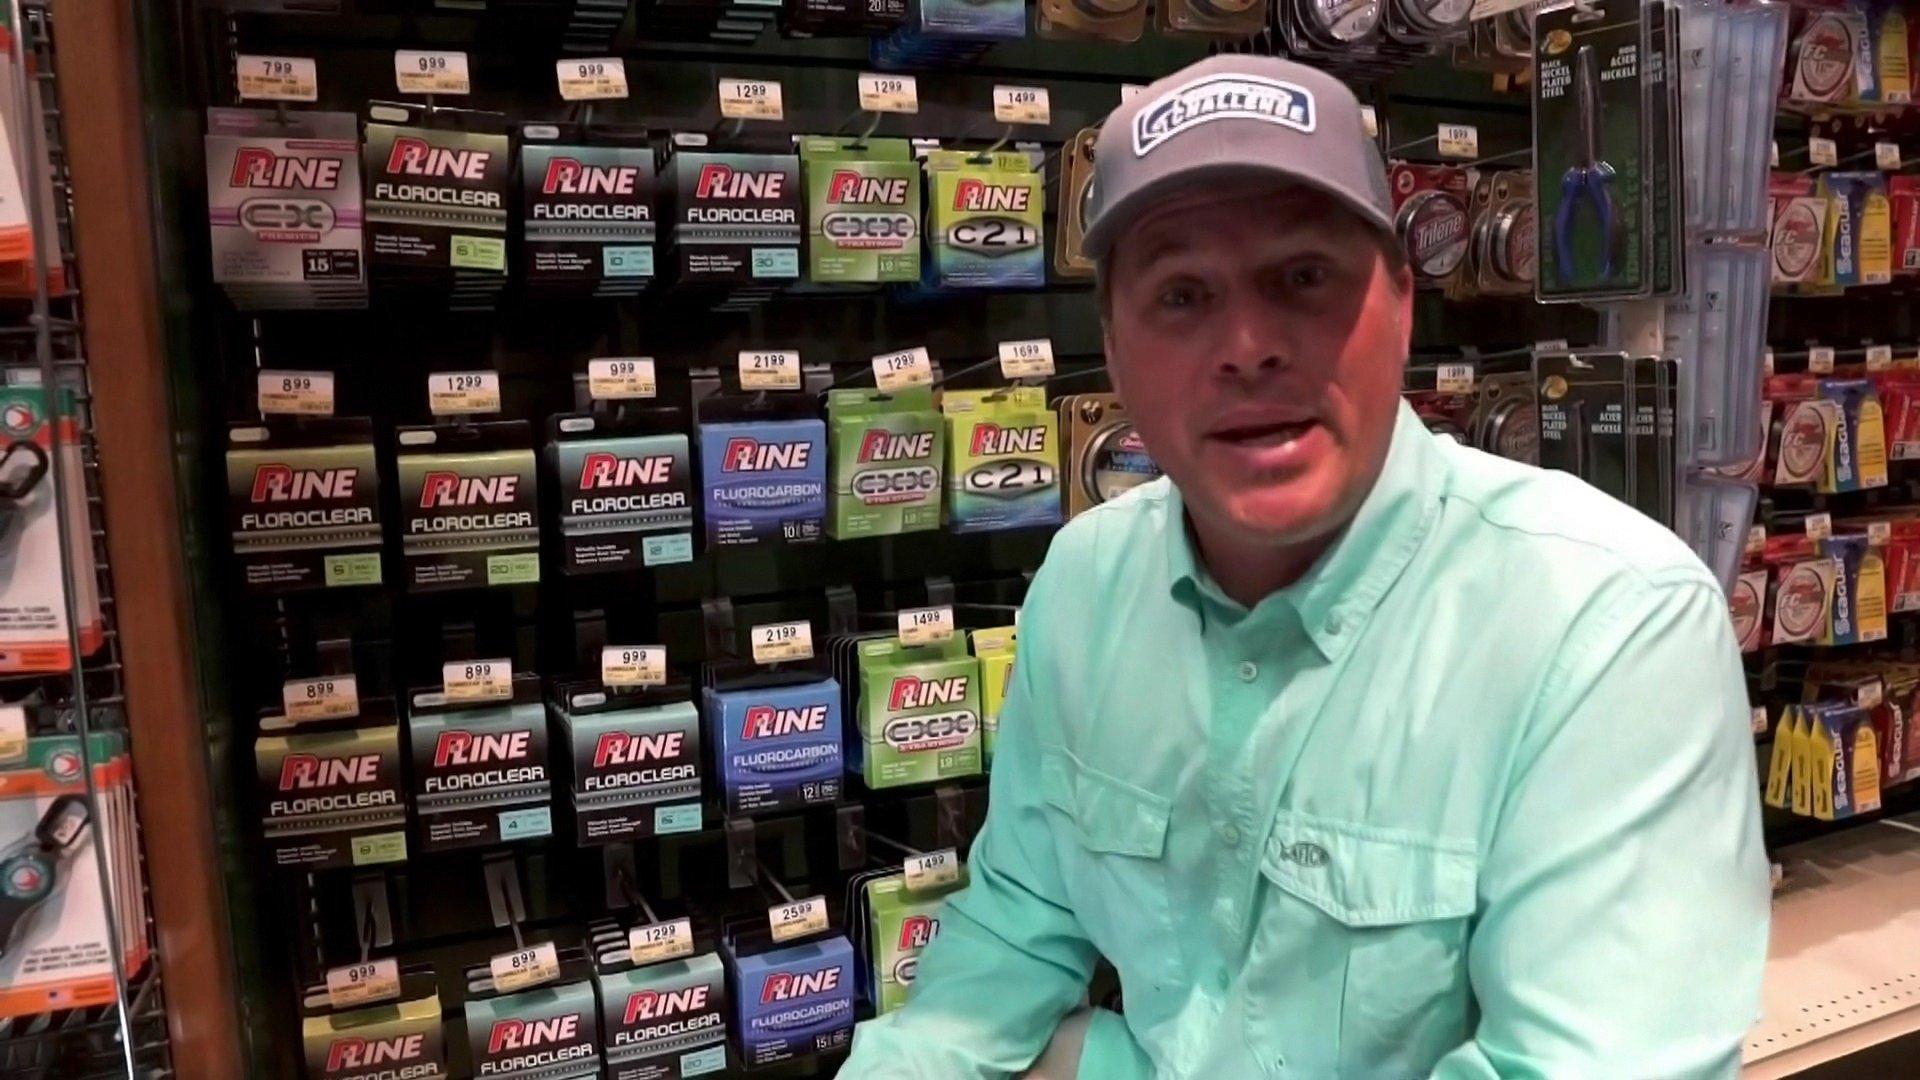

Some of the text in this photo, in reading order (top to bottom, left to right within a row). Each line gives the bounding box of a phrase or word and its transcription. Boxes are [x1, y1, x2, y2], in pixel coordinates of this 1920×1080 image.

[263, 61, 292, 77] 799
[419, 57, 446, 71] 999
[1610, 55, 1637, 67] ACIER
[578, 65, 604, 78] 999
[1541, 66, 1570, 79] NICKEL
[874, 80, 902, 93] 1299
[1542, 76, 1572, 89] PLATED
[736, 84, 766, 99] 1299
[1008, 92, 1036, 104] 1499
[1542, 87, 1565, 98] STEEL
[376, 184, 500, 207] FLOROCLEAR
[533, 204, 649, 220] FLOROCLEAR
[688, 208, 795, 223] FLOROCLEAR
[954, 221, 1029, 246] C21
[1418, 214, 1464, 250] Trilene
[308, 258, 329, 272] 15
[755, 258, 774, 268] 30
[1013, 344, 1040, 358] 1699
[610, 363, 635, 376] 999
[754, 355, 785, 369] 2199
[888, 353, 916, 371] 1299
[283, 377, 311, 392] 899
[447, 375, 482, 391] 1299
[1600, 412, 1622, 422] ACIER
[1542, 421, 1567, 430] PLATED
[971, 464, 1047, 489] C21
[713, 482, 821, 500] FLUOROCARBON
[571, 491, 686, 514] FLOROCLEAR
[242, 508, 372, 530] FLOROCLEAR
[411, 512, 532, 533] FLOROCLEAR
[783, 526, 796, 539] 10
[913, 610, 940, 626] 1499
[766, 627, 796, 642] 2199
[623, 650, 647, 664] 999
[465, 665, 491, 679] 899
[307, 682, 334, 698] 899
[733, 744, 839, 768] FLUOROCARBON
[426, 766, 544, 793] FLOROCLEAR
[585, 764, 696, 791] FLOROCLEAR
[803, 787, 814, 799] 12
[270, 790, 396, 817] FLOROCLEAR
[918, 855, 945, 871] 1499
[783, 903, 812, 920] 2599
[646, 924, 676, 941] 1299
[512, 950, 536, 968] 899
[349, 965, 376, 982] 999
[752, 998, 850, 1028] FLUOROCARBON
[615, 1012, 721, 1045] FLOROCLEAR
[817, 1038, 827, 1049] 15
[480, 1043, 593, 1075] FLOROCLEAR
